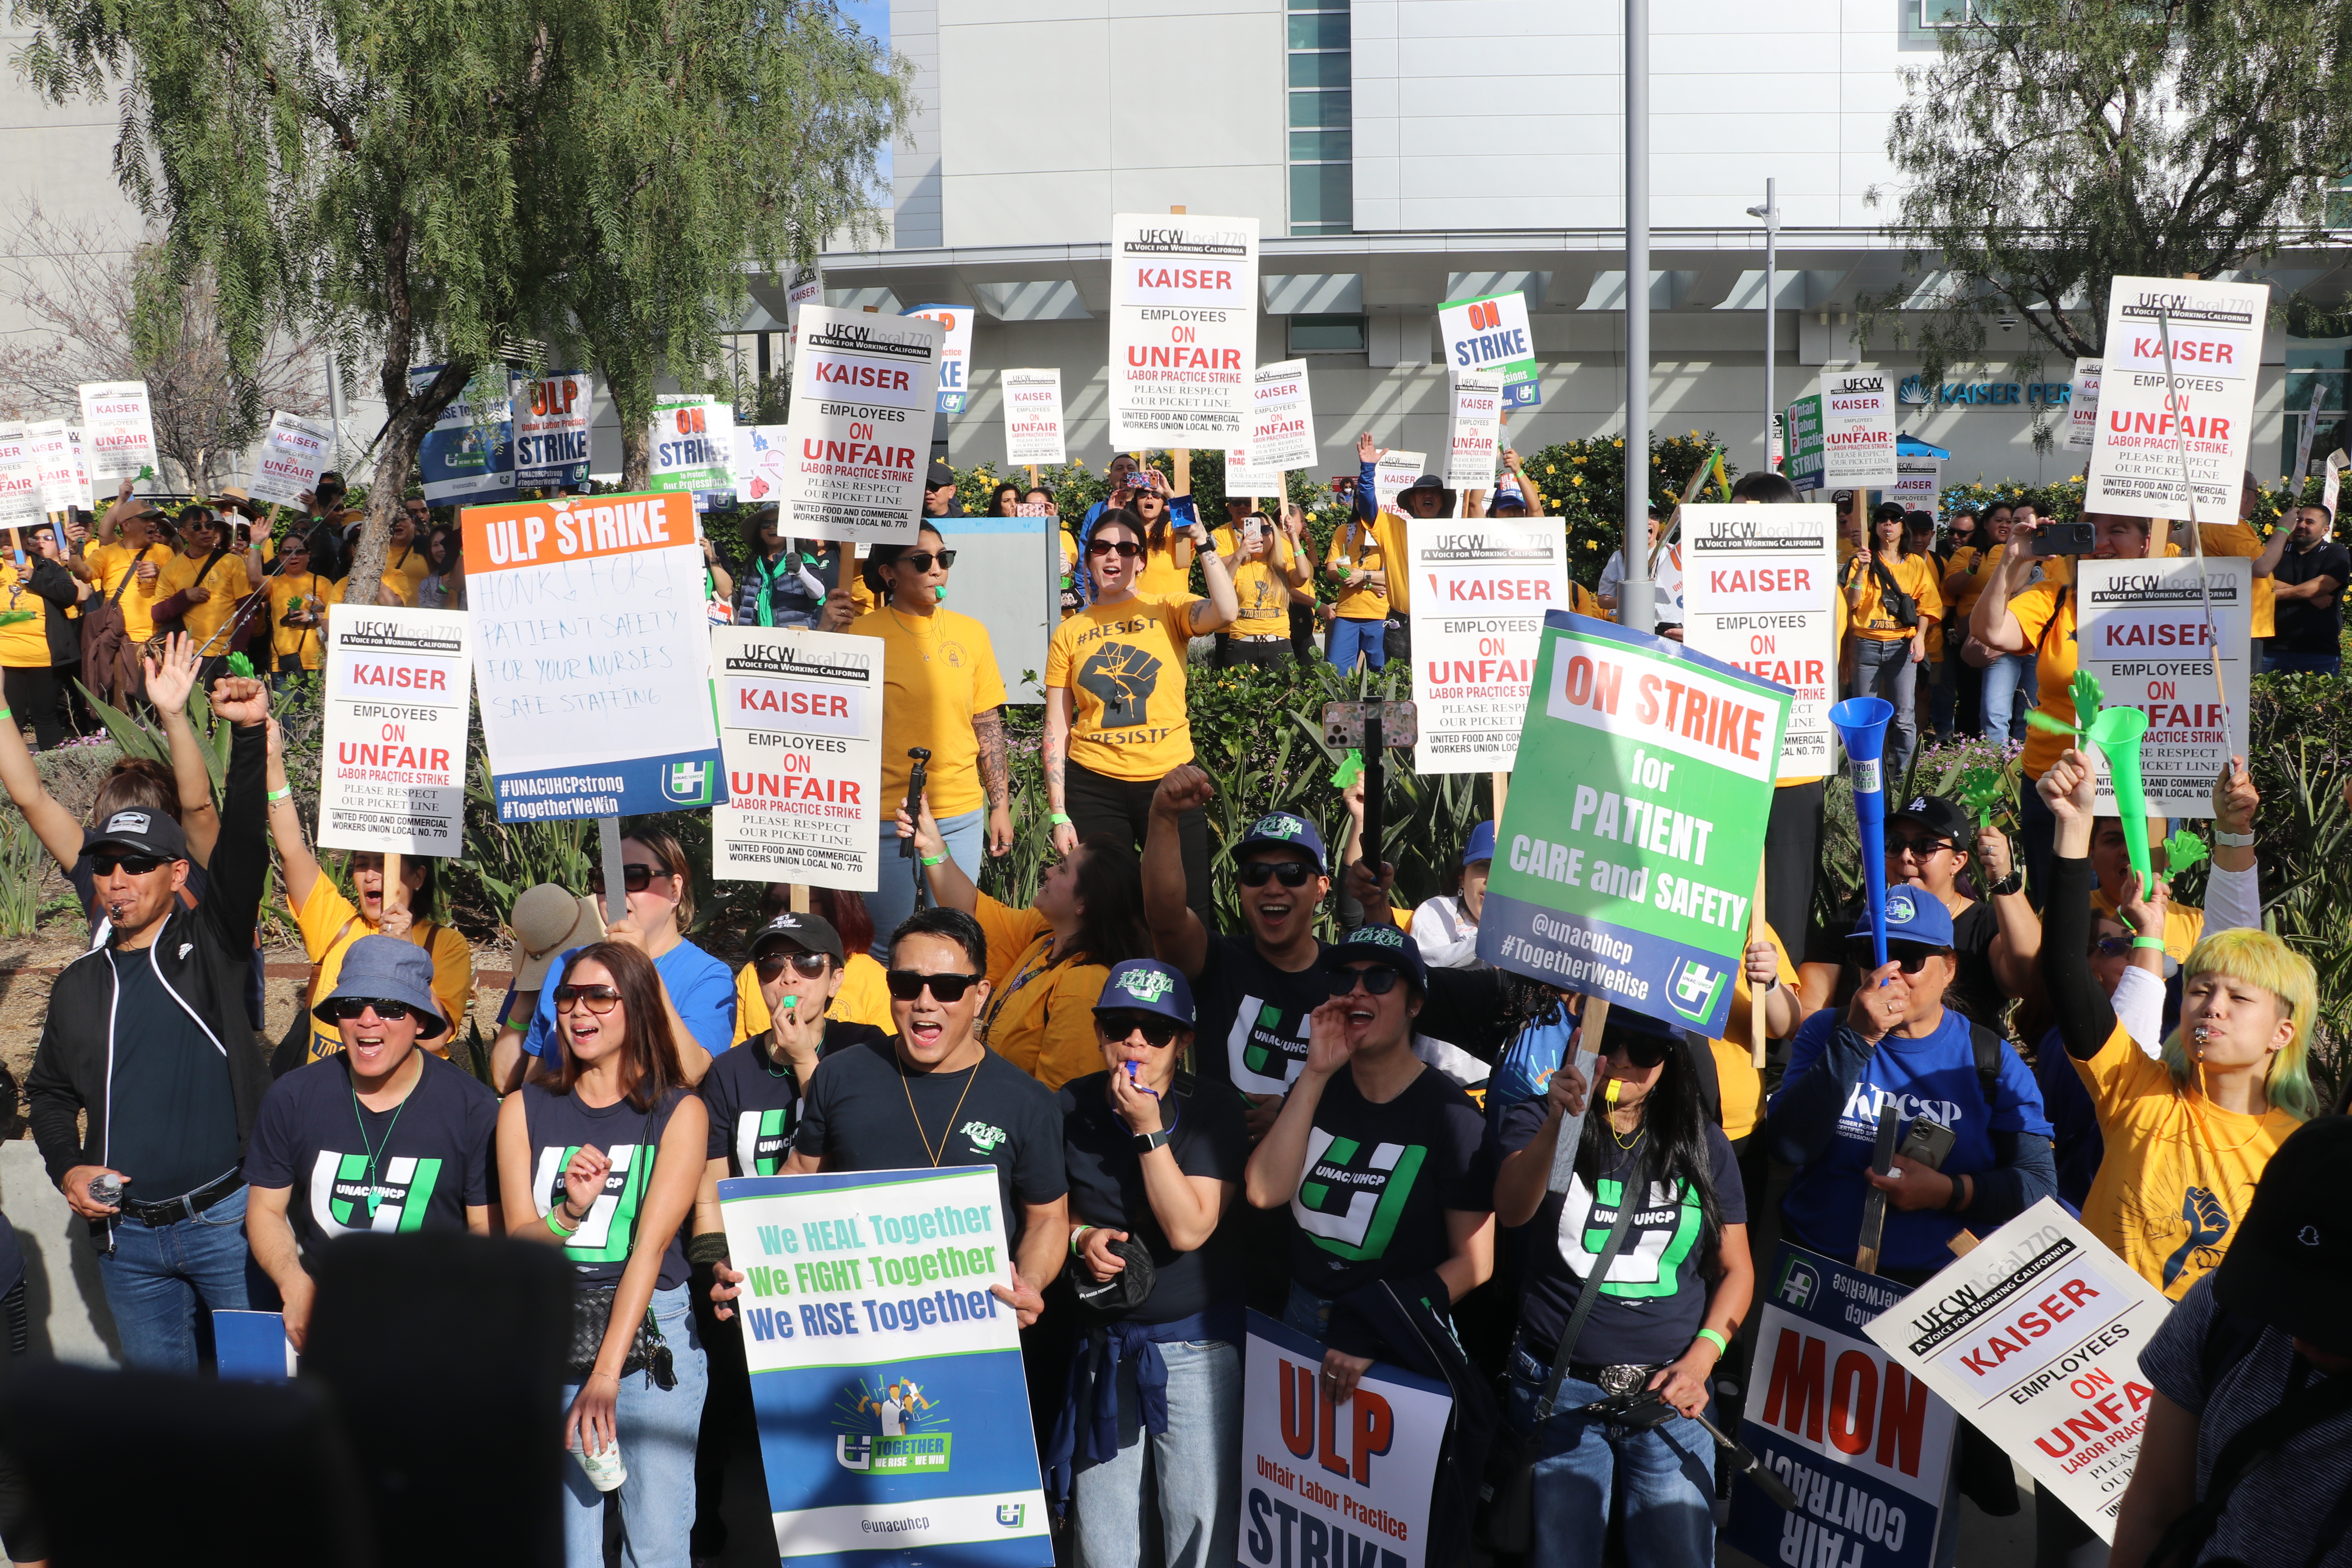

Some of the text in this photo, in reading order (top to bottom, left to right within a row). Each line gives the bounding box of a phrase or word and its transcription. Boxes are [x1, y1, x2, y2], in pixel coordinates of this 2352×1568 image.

[2139, 292, 2187, 309] UFCW
[1142, 309, 1226, 322] EMPLOYEES
[1468, 301, 1501, 331] ON
[826, 323, 932, 347] UFCW Local 770
[1172, 326, 1195, 343] ON
[820, 337, 840, 347] VOICE
[856, 342, 888, 350] WORKING
[889, 345, 928, 355] CALIFORNIA
[1455, 328, 1527, 365] STRIKE
[816, 362, 909, 391] KAISER
[1127, 370, 1241, 383] LABOR PRACTICE STRIKE
[1462, 378, 1478, 387] UFCW
[1844, 377, 1882, 389] UFCW
[530, 380, 578, 416] ULP
[1015, 392, 1052, 401] KAISER
[1940, 383, 2021, 403] KAISER
[96, 404, 139, 413] KAISER
[1255, 404, 1296, 414] EMPLOYEES
[1461, 398, 1493, 410] KAISER
[1833, 399, 1879, 410] KAISER
[676, 408, 706, 435] ON
[821, 404, 905, 422] EMPLOYEES
[1270, 414, 1282, 422] ON
[522, 422, 541, 431] Unfair
[562, 418, 585, 427] Practice
[849, 423, 873, 440] ON
[1012, 423, 1057, 432] UNFAIR
[1469, 428, 1478, 436] ON
[95, 434, 147, 446] UNFAIR
[277, 432, 319, 450] KAISER
[518, 430, 586, 465] STRIKE
[1453, 437, 1492, 449] UNFAIR
[2108, 435, 2229, 454] LABOR STRIKE
[276, 448, 313, 461] EMPLOYEES
[659, 437, 729, 466] STRIKE
[804, 439, 915, 469] UNFAIR
[801, 462, 913, 482] LABOR PRACTICE STRIKE
[1384, 474, 1416, 484] KAISER
[1501, 474, 1515, 483] ULP
[679, 477, 727, 490] Professions
[808, 478, 902, 494] PLEASE RESPECT
[1895, 481, 1931, 489] KAISER
[2103, 478, 2173, 492] UNITED FOOD AND
[805, 489, 902, 505] OUR PICKET LINE
[2211, 496, 2226, 505] 770
[793, 512, 829, 523] WORKERS
[831, 515, 854, 524] UNION
[856, 517, 879, 526] LOCAL
[794, 503, 820, 513] UNITED
[822, 506, 842, 515] FOOD
[861, 509, 908, 519] COMMERCIAL
[486, 499, 670, 564] ULP STRIKE
[589, 553, 653, 596] FOR
[2109, 575, 2159, 592] UFCW
[356, 621, 398, 637] UFCW
[477, 611, 678, 650] PATIENT SAFETY
[1445, 620, 1537, 633] EMPLOYEES
[1717, 615, 1806, 630] EMPLOYEES
[1873, 620, 1885, 629] 770
[1077, 618, 1157, 646] #RESIST
[488, 646, 673, 684] FOR YOUR NURSES
[2112, 663, 2213, 676] EMPLOYEES
[493, 687, 662, 719] SAFE STAFFING
[1565, 655, 1766, 762] ON STRIKE
[354, 706, 437, 721] EMPLOYEES
[1631, 748, 1675, 793] for
[501, 775, 624, 797] #UNACUHCPstrong
[503, 796, 619, 819] #TogetherWeWin
[1908, 797, 1927, 811] LA
[1570, 784, 1714, 866] PATIENT
[1509, 834, 1748, 933] CARE and SAFETY
[1532, 913, 1633, 965] @unacuhcp
[1501, 935, 1649, 1001] #TogetherWeRise
[1145, 973, 1174, 983] ANGELES
[1837, 1125, 1864, 1134] CERTIFIED
[1315, 1165, 1386, 1187] UNAC/UHCP
[336, 1184, 406, 1199] UNAC/UHCP
[757, 1204, 992, 1255] We HEAL Together
[746, 1245, 996, 1297] We FIGHT Together
[747, 1289, 997, 1341] We RISE Together
[1959, 1278, 2102, 1377] KAISER
[2009, 1323, 2131, 1405] EMPLOYEES
[1762, 1327, 1928, 1479] NOW
[1279, 1357, 1394, 1489] ULP
[876, 1438, 944, 1456] TOGETHER
[875, 1455, 945, 1467] WE RISE WE WIN
[1257, 1454, 1407, 1541] Unfair Labor Practice
[861, 1515, 930, 1535] @unacuhcp
